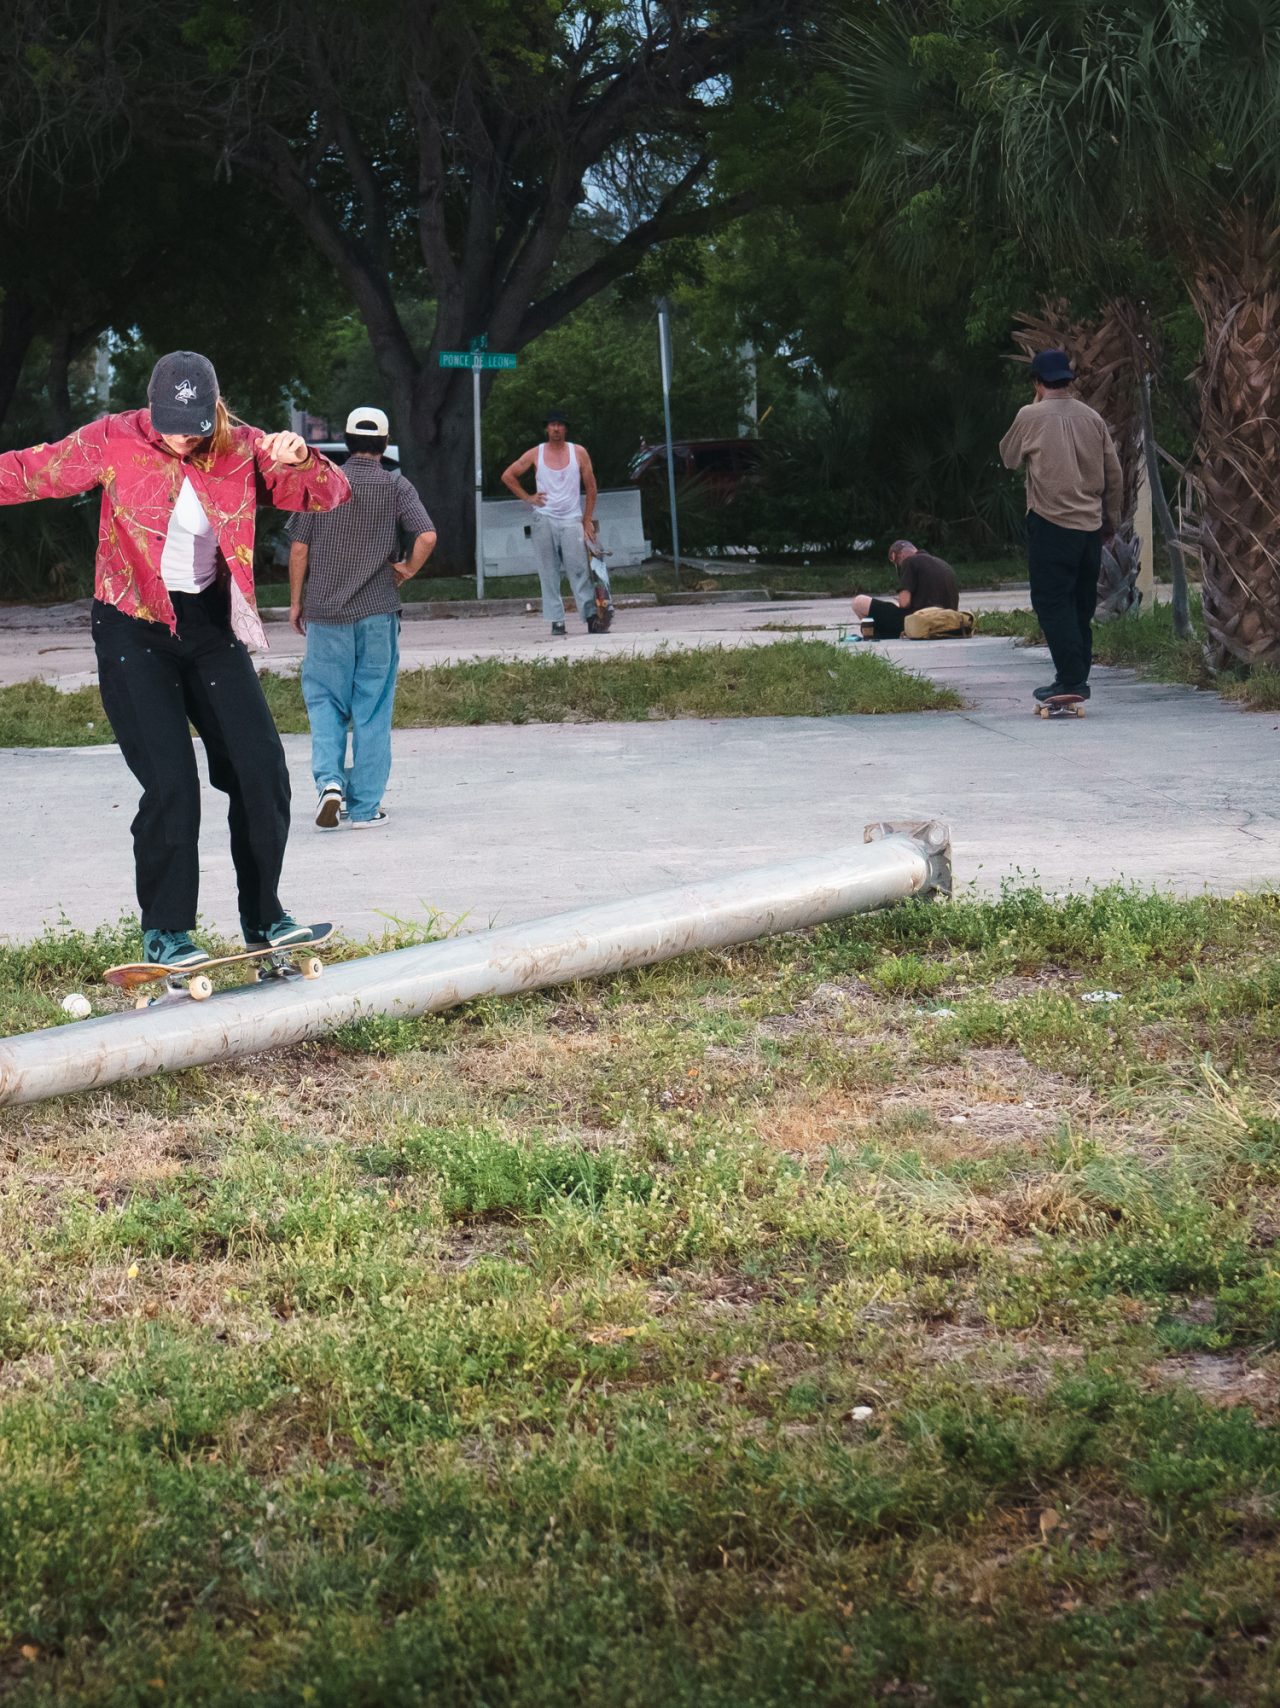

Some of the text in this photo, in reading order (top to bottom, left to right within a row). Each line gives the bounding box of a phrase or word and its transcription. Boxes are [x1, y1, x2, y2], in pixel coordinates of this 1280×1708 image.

[443, 355, 470, 367] PONCE
[473, 355, 483, 366] DE
[488, 356, 509, 367] LEON
